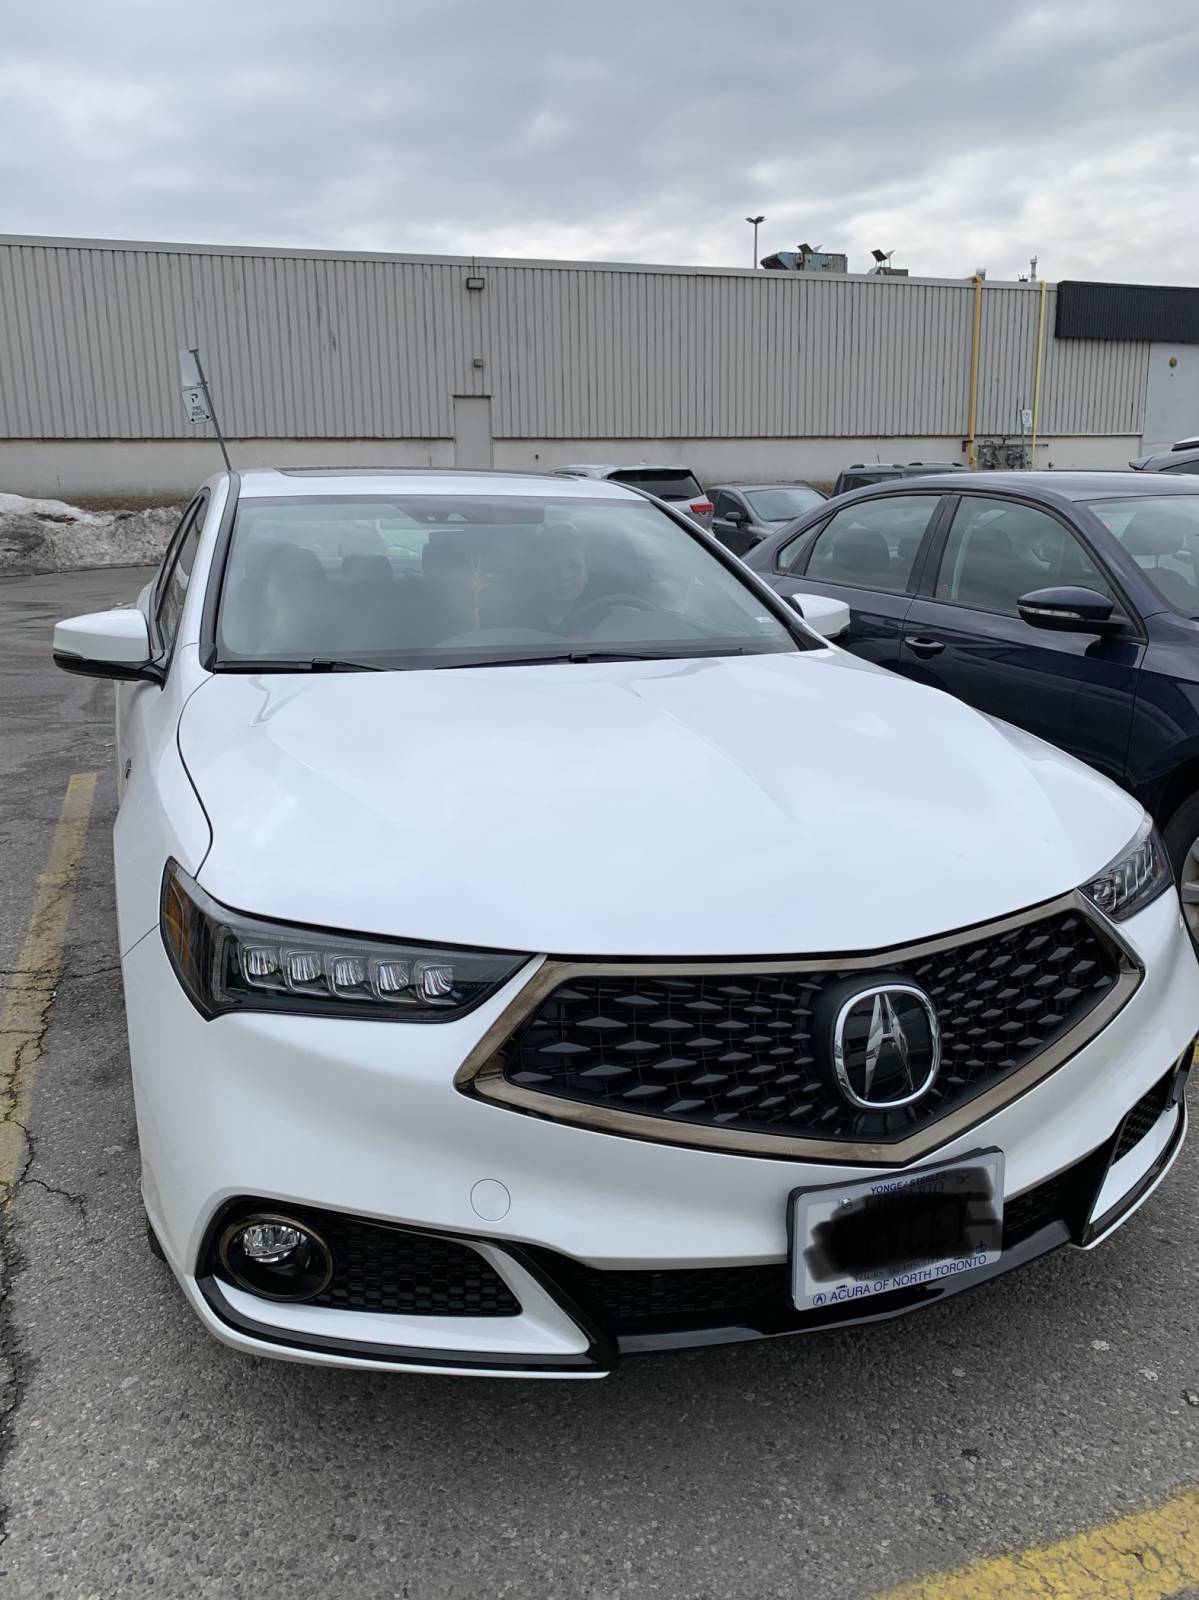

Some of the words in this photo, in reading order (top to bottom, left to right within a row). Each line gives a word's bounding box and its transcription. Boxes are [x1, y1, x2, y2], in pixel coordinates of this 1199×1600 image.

[830, 1285, 871, 1302] ACURA
[874, 1281, 890, 1292] OF
[892, 1270, 932, 1289] NORTH
[935, 1254, 987, 1276] TORONTO
